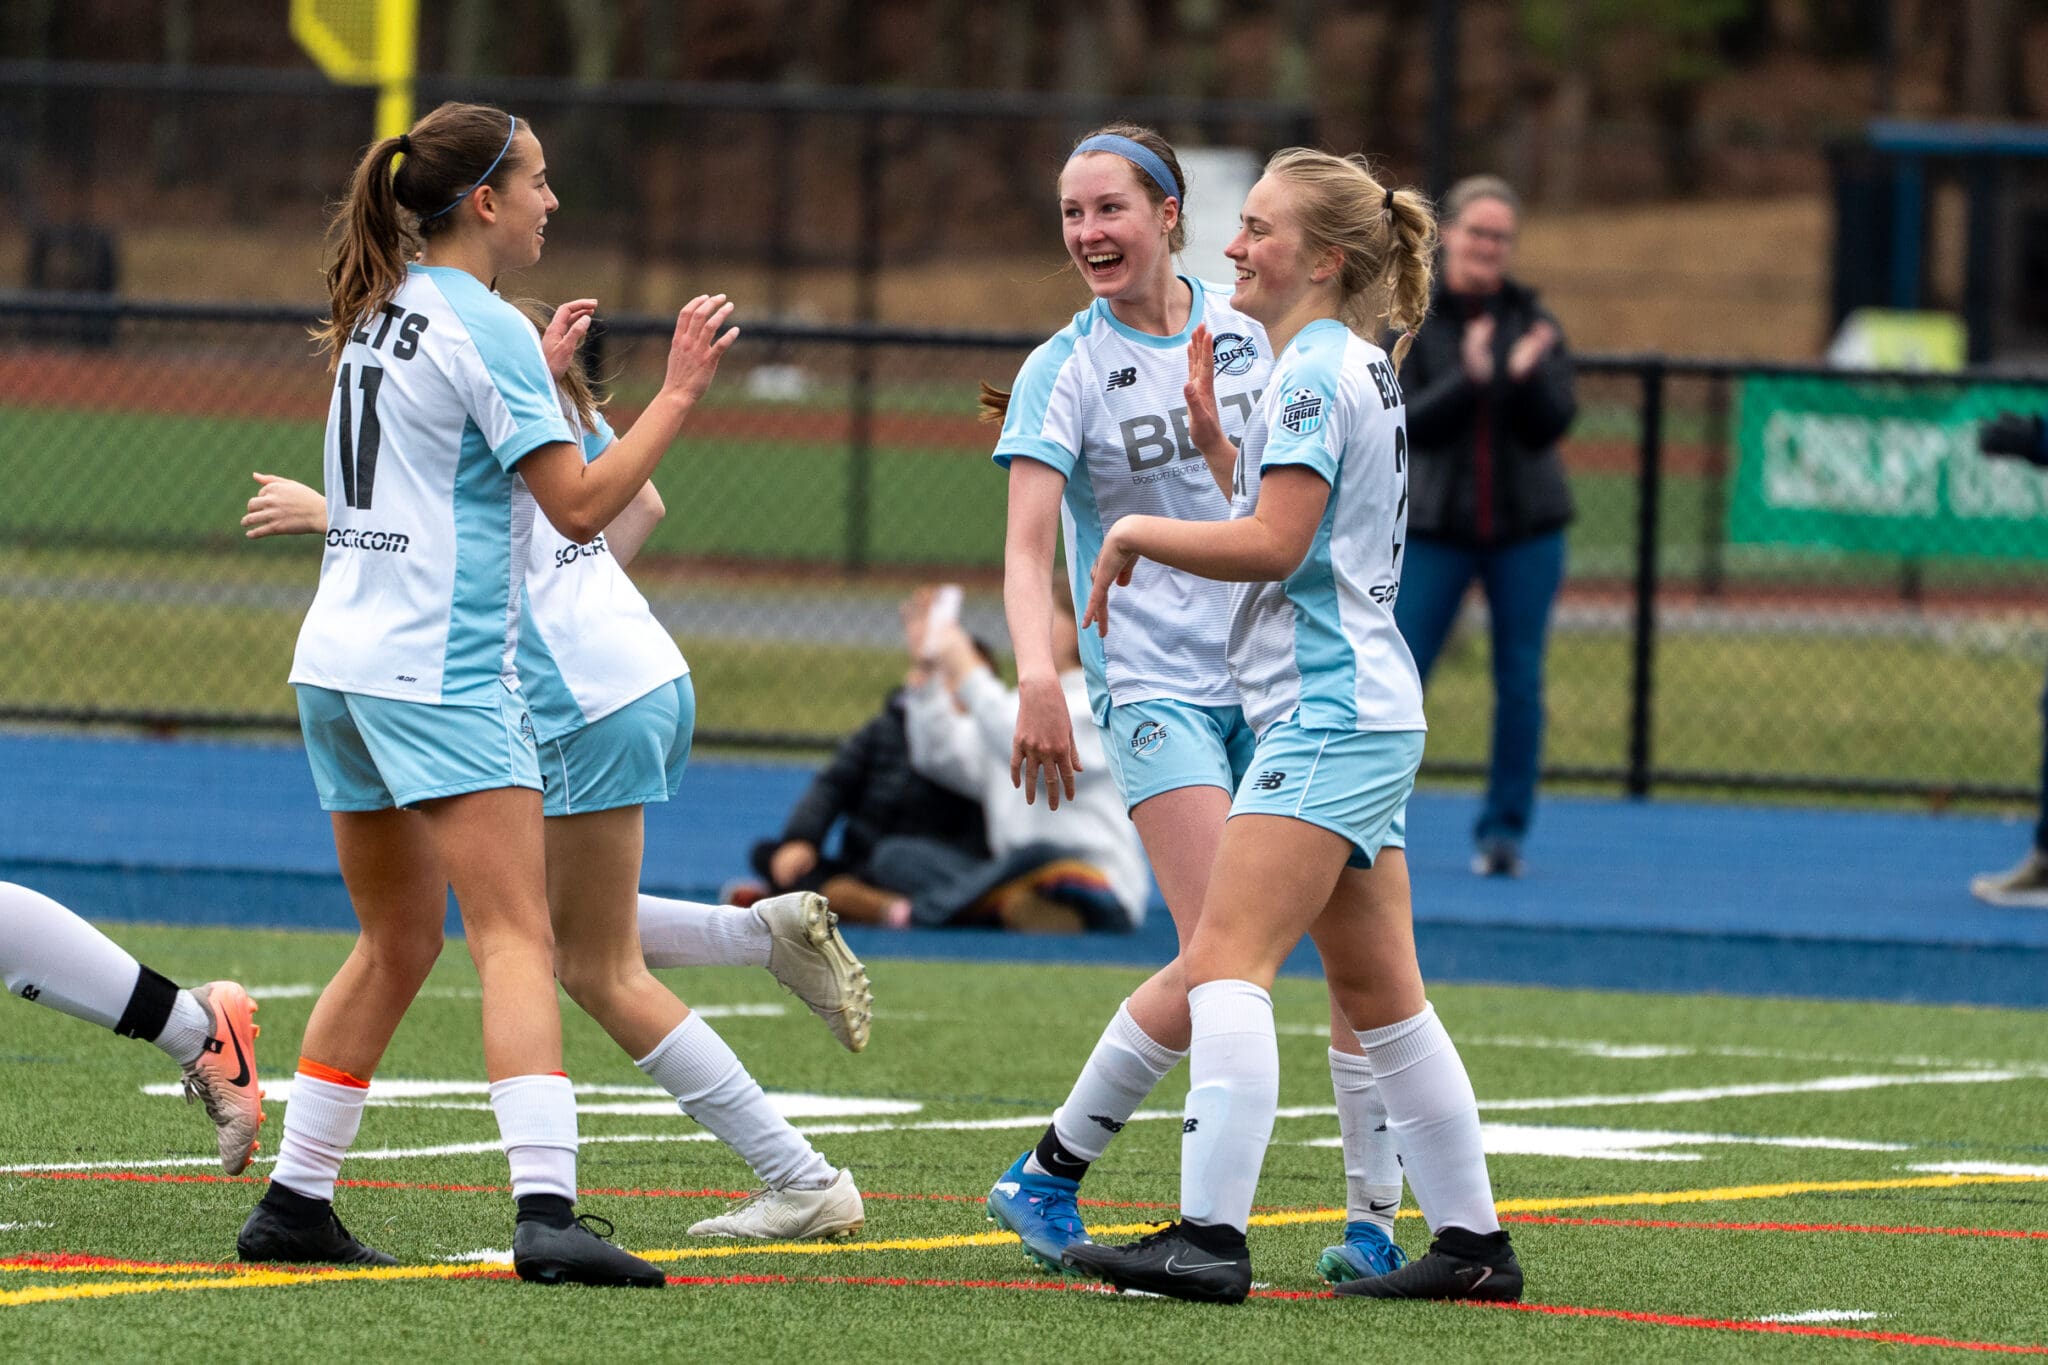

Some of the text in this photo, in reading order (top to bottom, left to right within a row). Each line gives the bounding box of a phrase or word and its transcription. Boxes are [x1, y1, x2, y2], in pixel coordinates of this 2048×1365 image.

[1282, 405, 1321, 425] LEAGUE
[338, 362, 384, 510] 11
[1132, 470, 1171, 485] Boston
[1172, 462, 1200, 478] Bone
[1131, 730, 1167, 748] BOLTS
